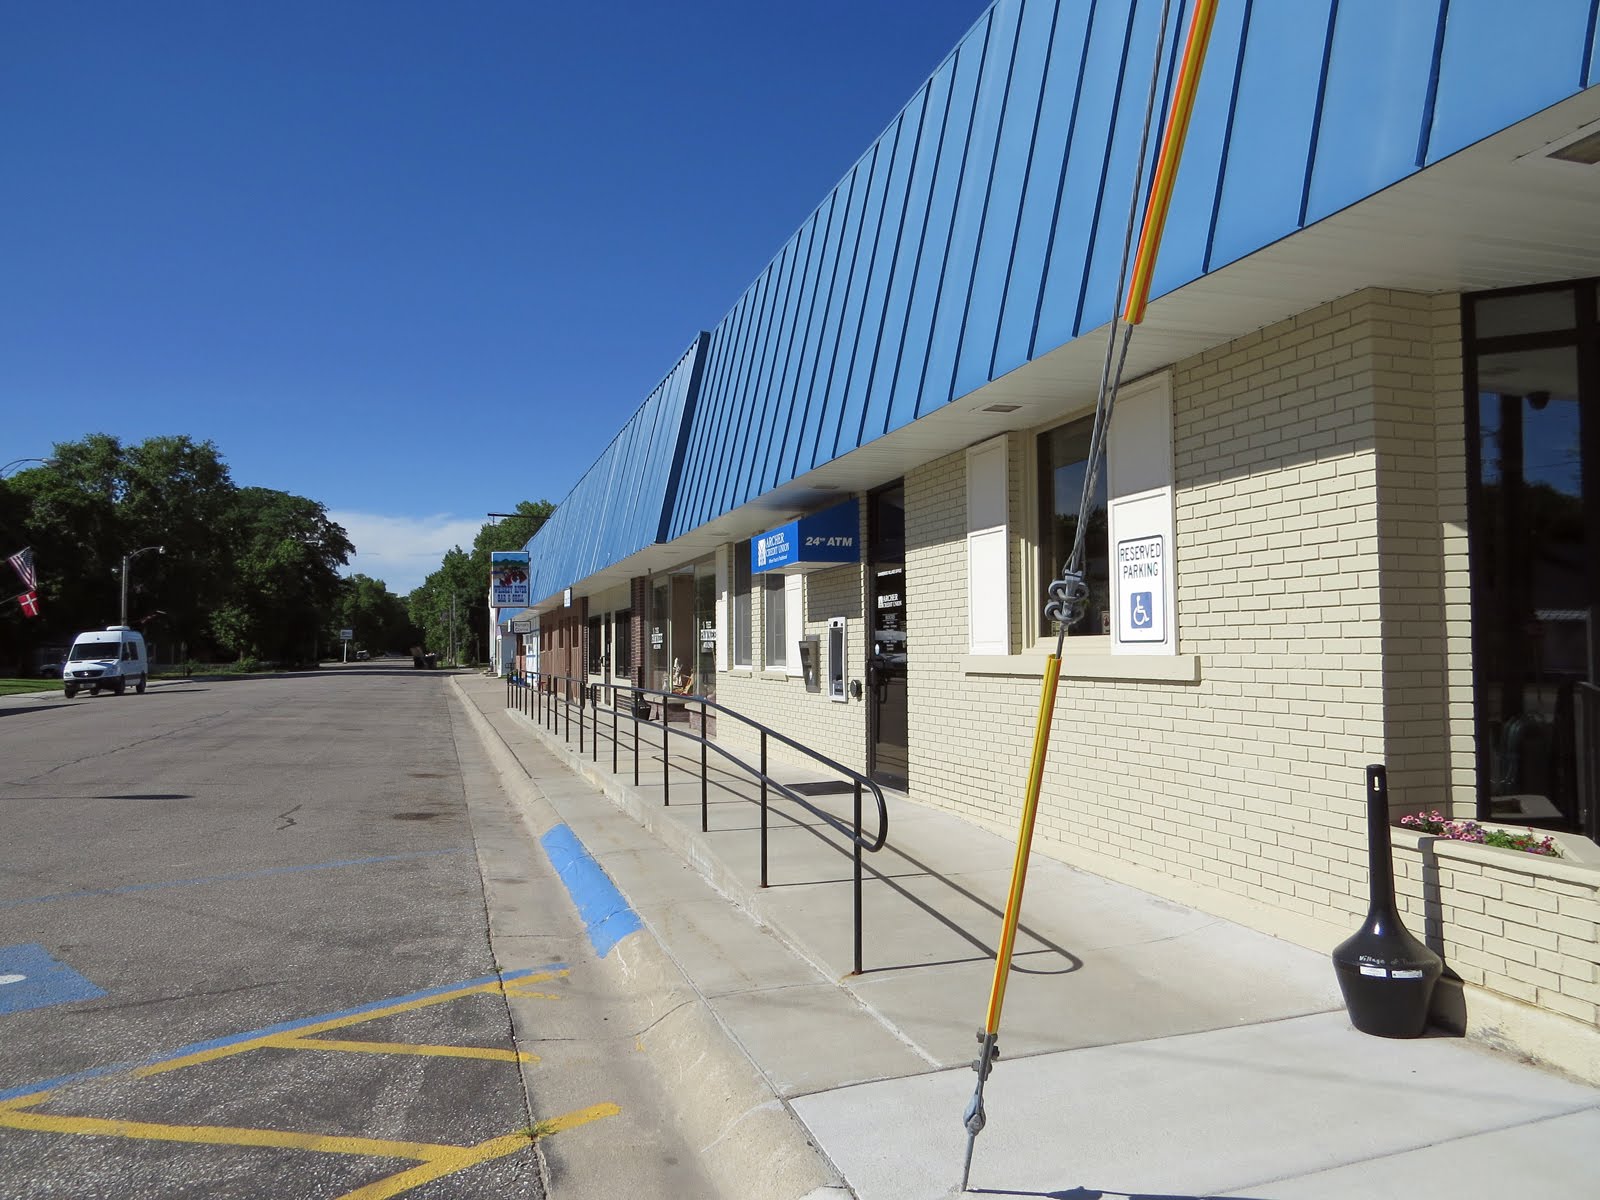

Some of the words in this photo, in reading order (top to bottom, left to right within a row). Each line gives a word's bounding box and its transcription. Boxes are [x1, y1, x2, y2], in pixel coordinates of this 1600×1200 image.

[766, 532, 785, 548] ARCHER
[827, 537, 853, 547] ATM
[766, 546, 778, 557] CREDIT
[778, 542, 790, 554] UNION
[1120, 542, 1161, 562] RESERVED
[1123, 562, 1158, 580] PARKING
